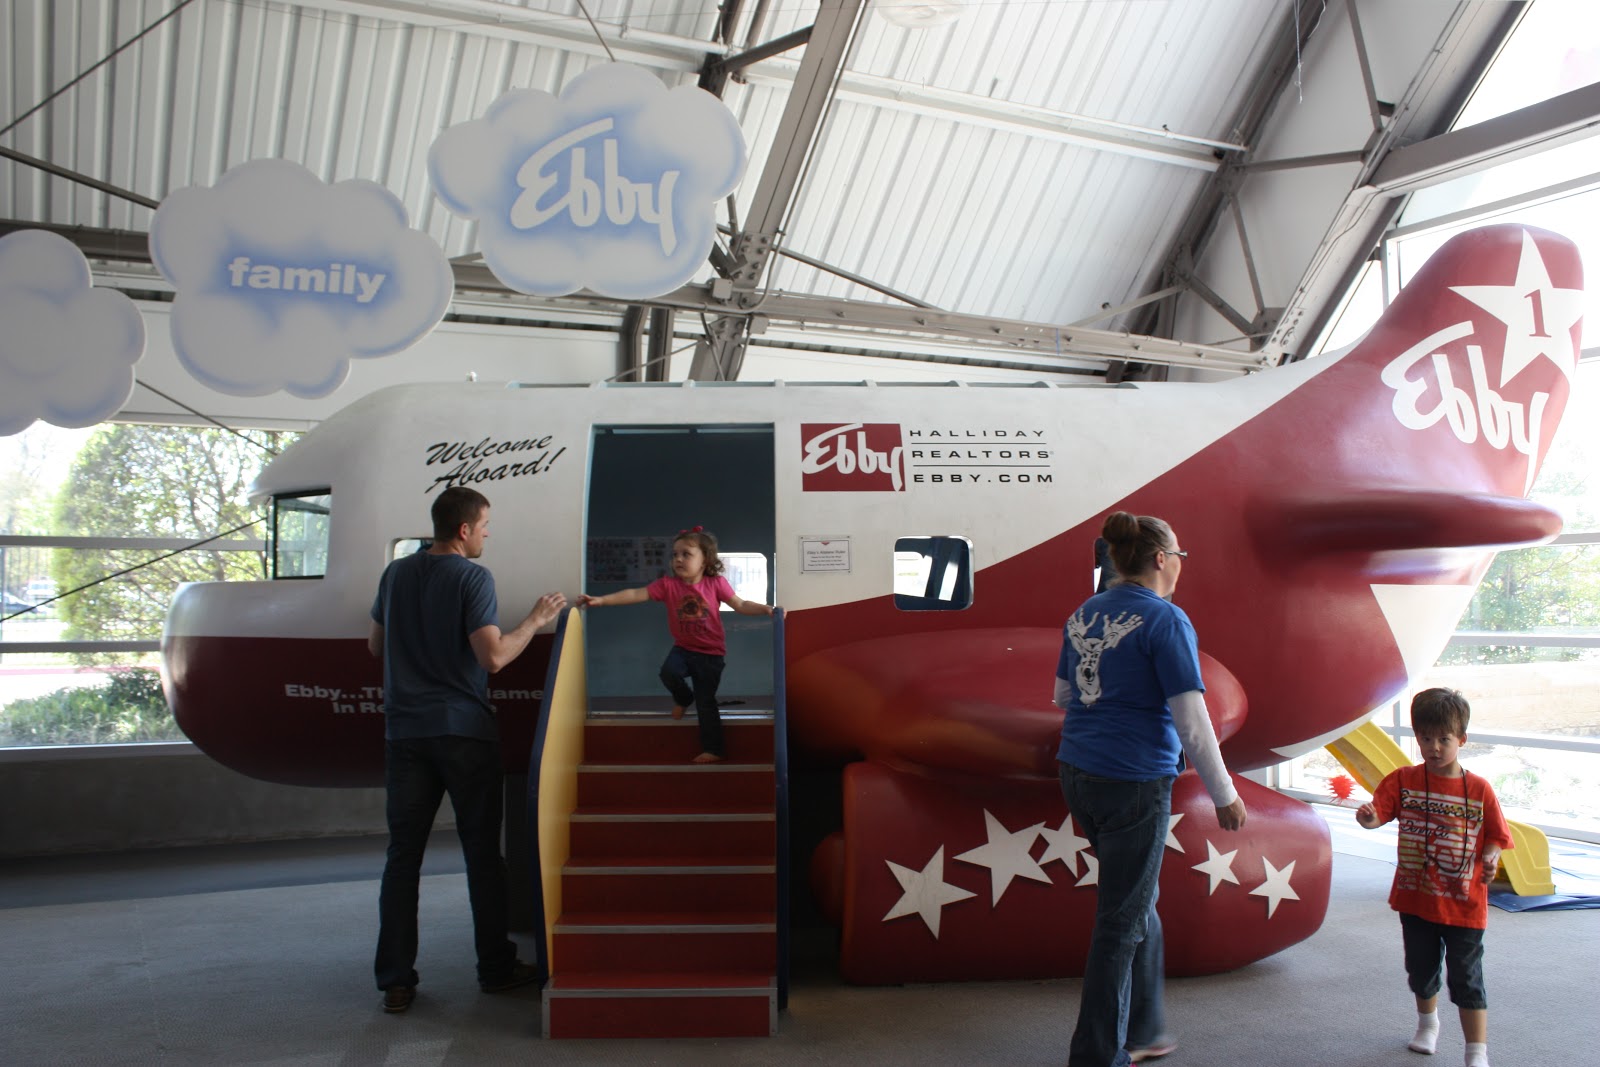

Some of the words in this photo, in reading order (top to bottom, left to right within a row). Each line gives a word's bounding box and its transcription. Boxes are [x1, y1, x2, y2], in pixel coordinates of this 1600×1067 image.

[510, 117, 681, 257] Ebby
[228, 257, 386, 303] family
[1524, 289, 1552, 338] 1
[1380, 320, 1550, 498] Ebby
[426, 435, 553, 466] Welcome
[909, 430, 1044, 438] HALLIDAY
[424, 447, 567, 494] Aboard!
[801, 423, 904, 492] Ebby
[913, 474, 1053, 483] EBBY.COM
[332, 702, 356, 714] In
